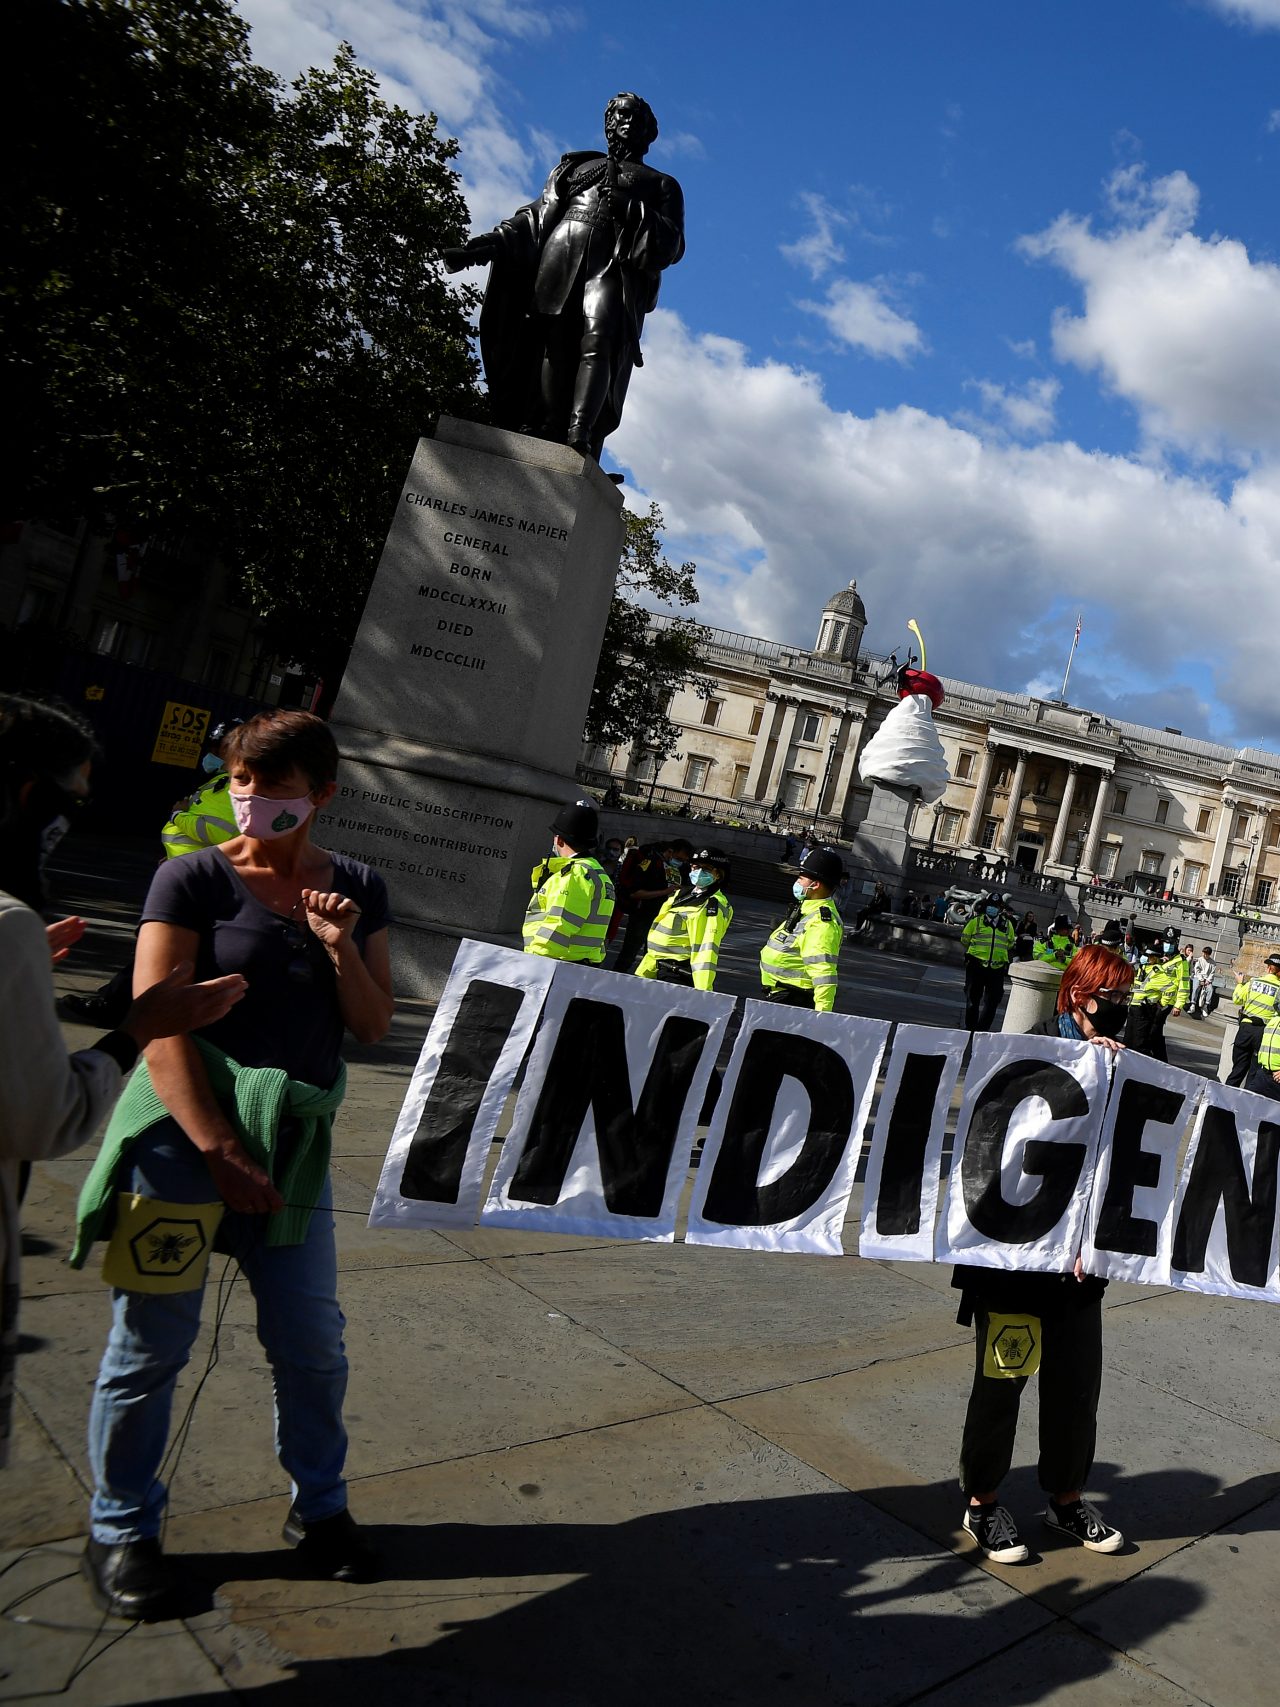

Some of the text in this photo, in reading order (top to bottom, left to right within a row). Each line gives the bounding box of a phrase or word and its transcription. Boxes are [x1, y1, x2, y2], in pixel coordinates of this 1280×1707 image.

[405, 492, 568, 541] CHARLES JAMES NAPIER
[443, 532, 509, 556] GENERAL
[450, 562, 492, 581] BORN
[418, 585, 507, 615] MDCCLXXXII
[437, 619, 474, 637] DIED
[409, 644, 486, 670] MDCCCLIII
[341, 786, 514, 830] BY PUBLIC SUBSCRIPTION
[319, 814, 508, 860] ST NUMEROUS CONTRIBUTORS
[398, 861, 467, 883] SOLDIERS
